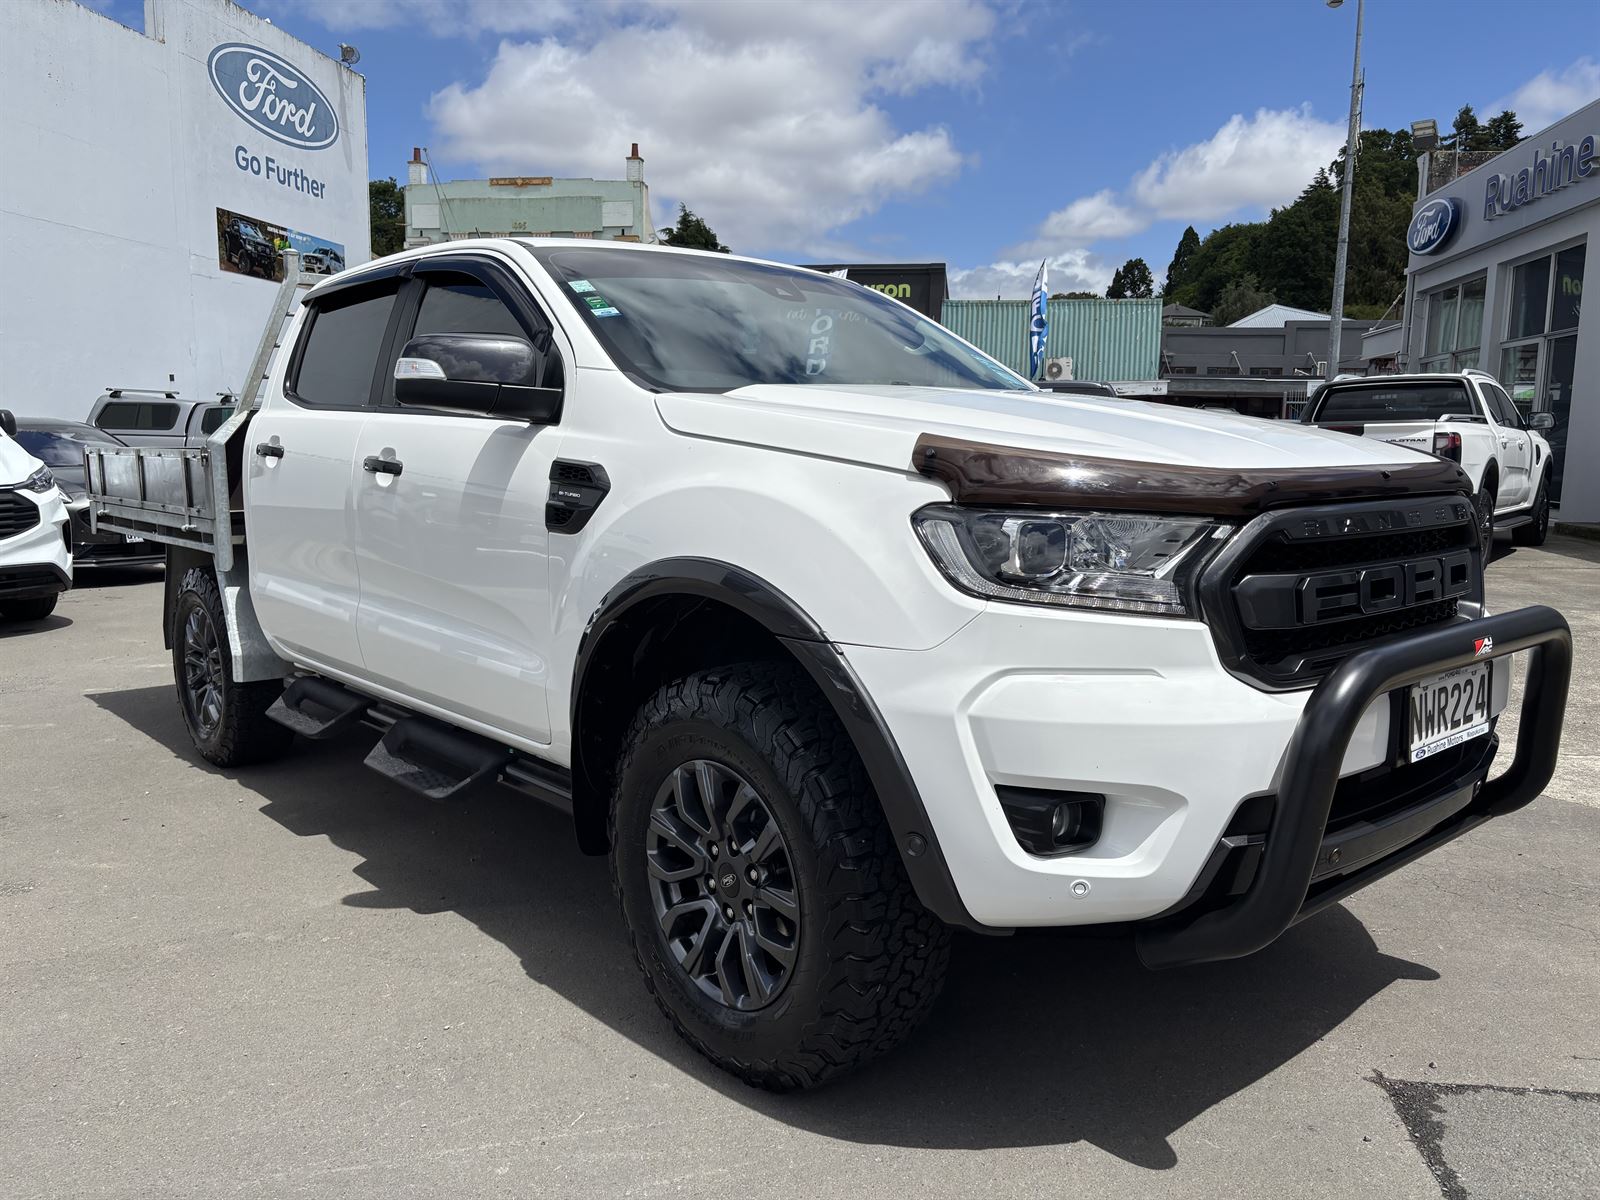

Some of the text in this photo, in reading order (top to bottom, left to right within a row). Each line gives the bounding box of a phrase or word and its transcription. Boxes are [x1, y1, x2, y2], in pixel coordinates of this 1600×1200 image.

[239, 58, 316, 138] Ford
[235, 145, 326, 199] Go Further
[1483, 135, 1597, 221] Ruahine
[1413, 207, 1442, 248] Ford
[1301, 549, 1473, 625] FORD
[1410, 674, 1486, 745] NWR224
